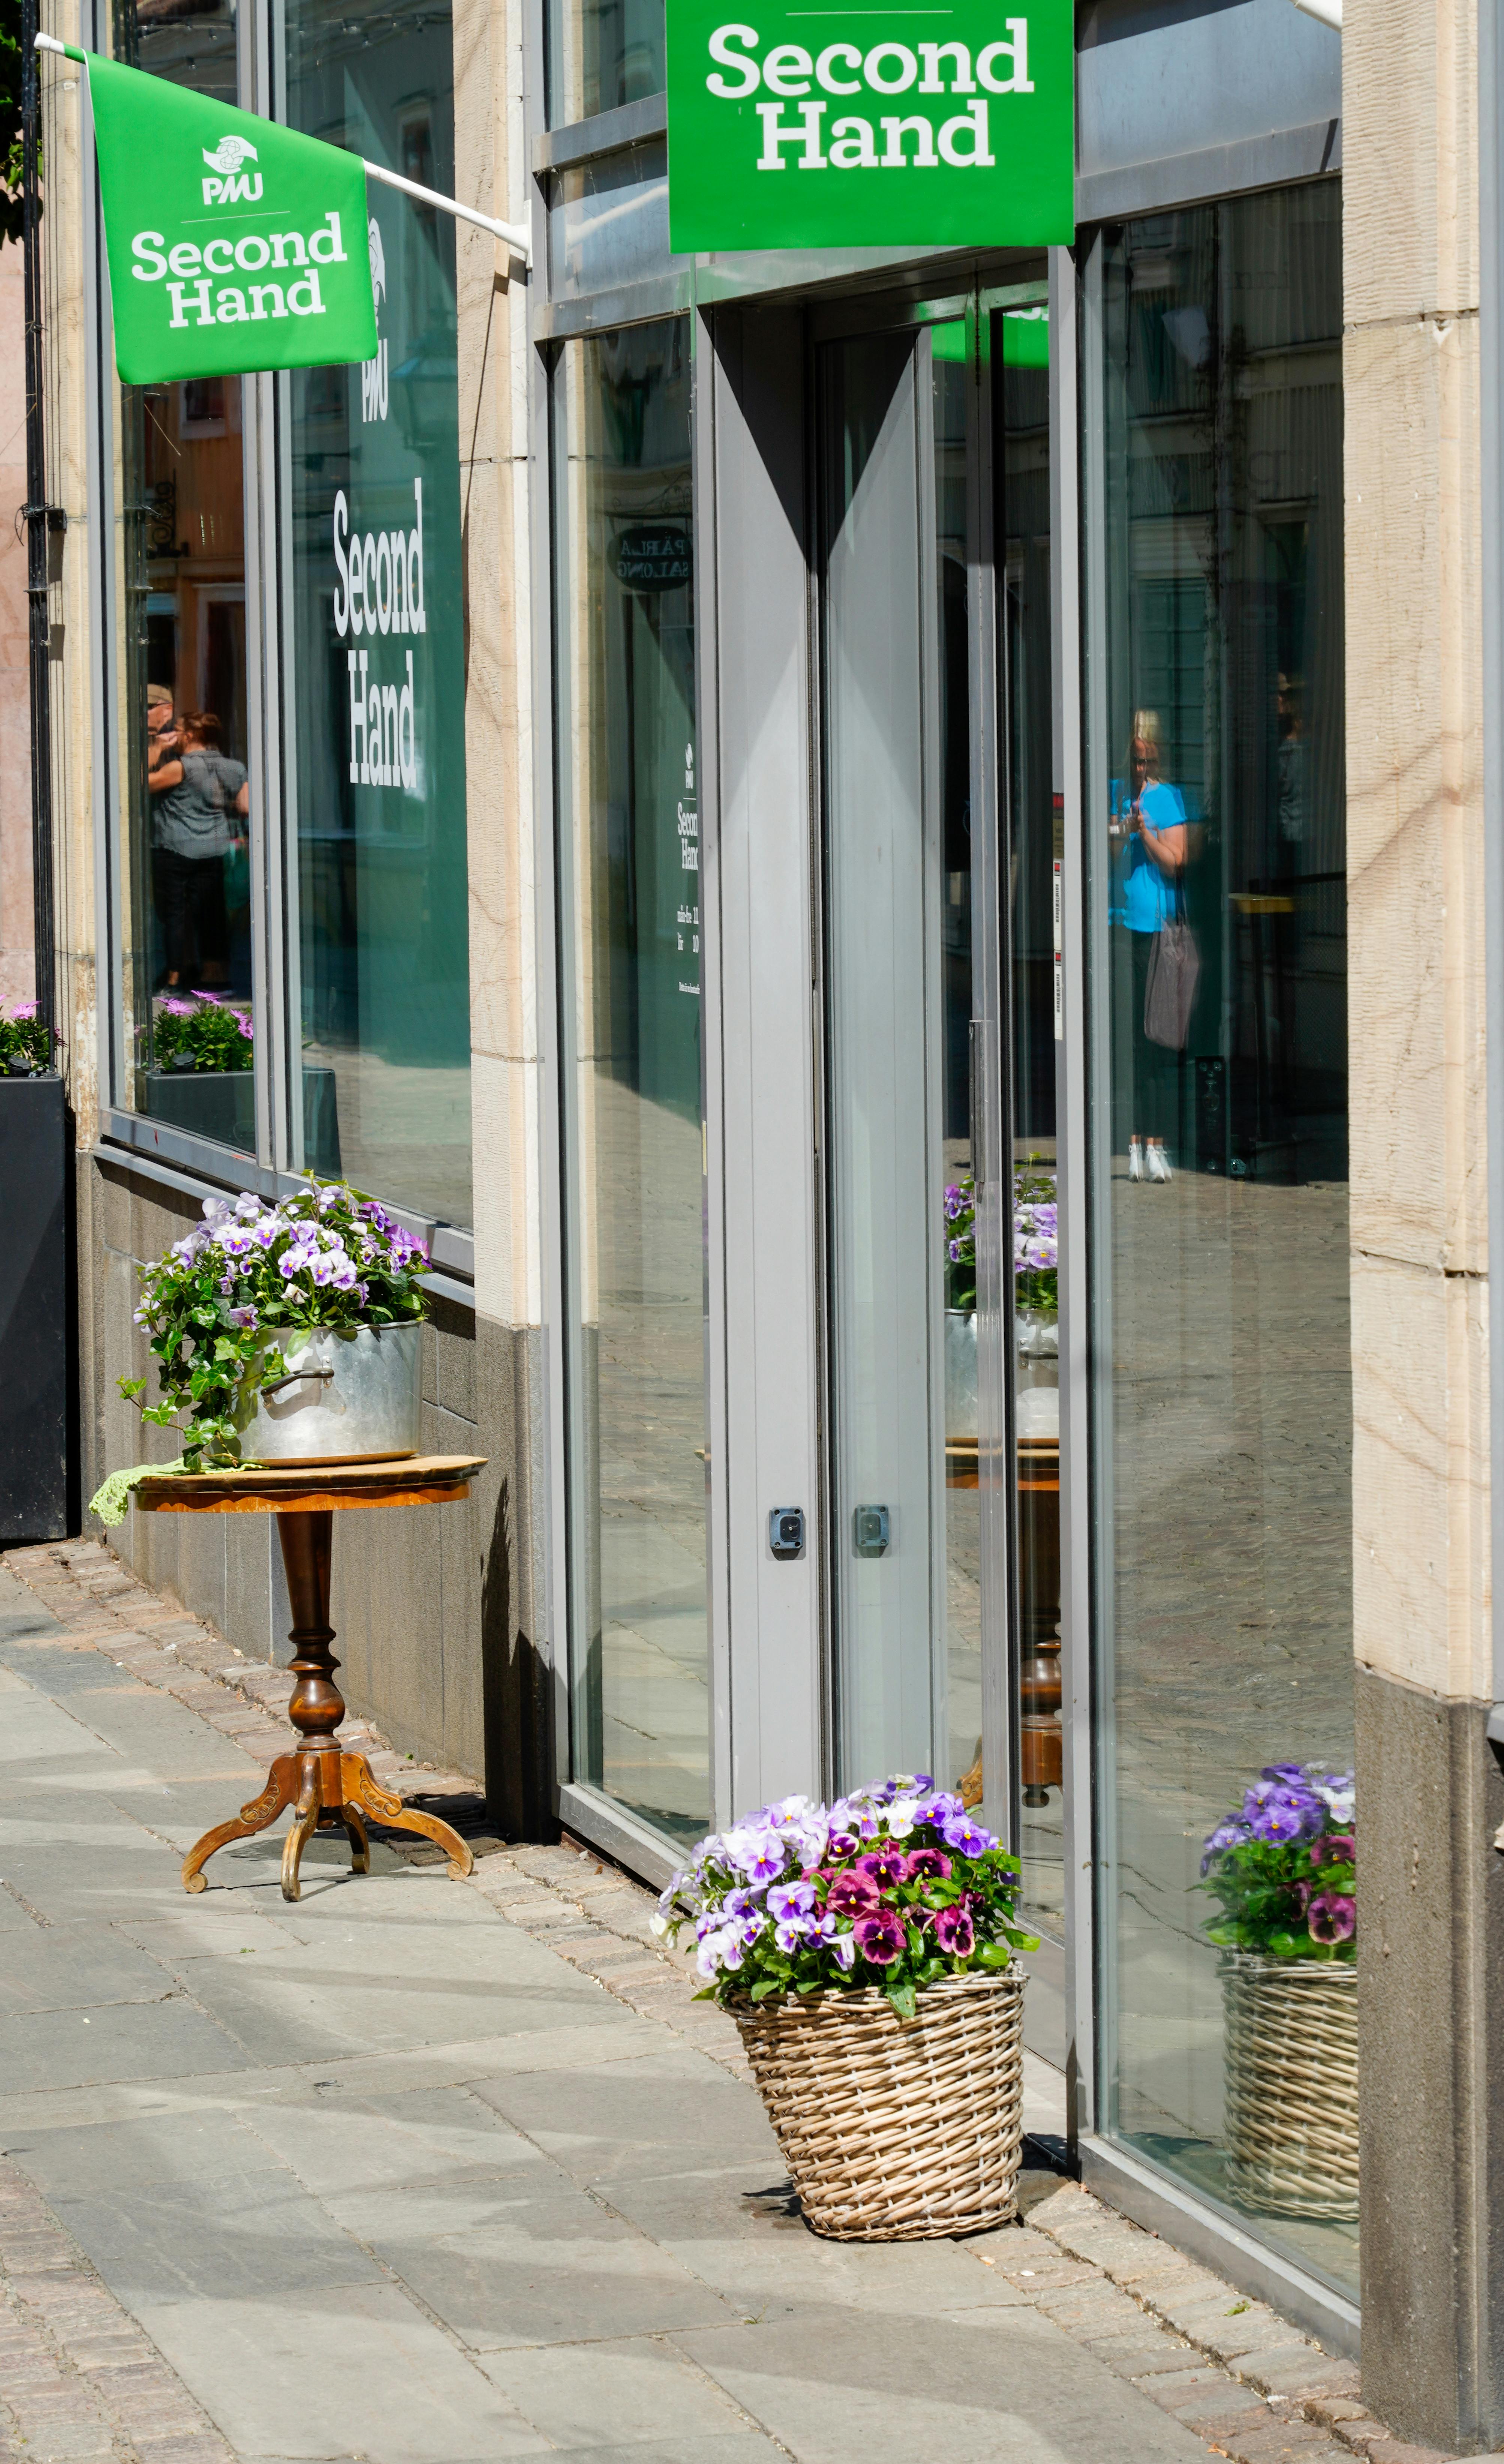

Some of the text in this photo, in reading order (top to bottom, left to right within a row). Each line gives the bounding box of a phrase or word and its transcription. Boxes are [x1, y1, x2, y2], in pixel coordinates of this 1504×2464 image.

[706, 18, 1035, 99] Second
[755, 99, 995, 170] Hand
[202, 172, 264, 205] PMU
[131, 211, 348, 281] Second
[166, 268, 326, 328] Hand
[333, 477, 426, 637] Second
[348, 650, 417, 789] Hand
[678, 802, 698, 836] Secon
